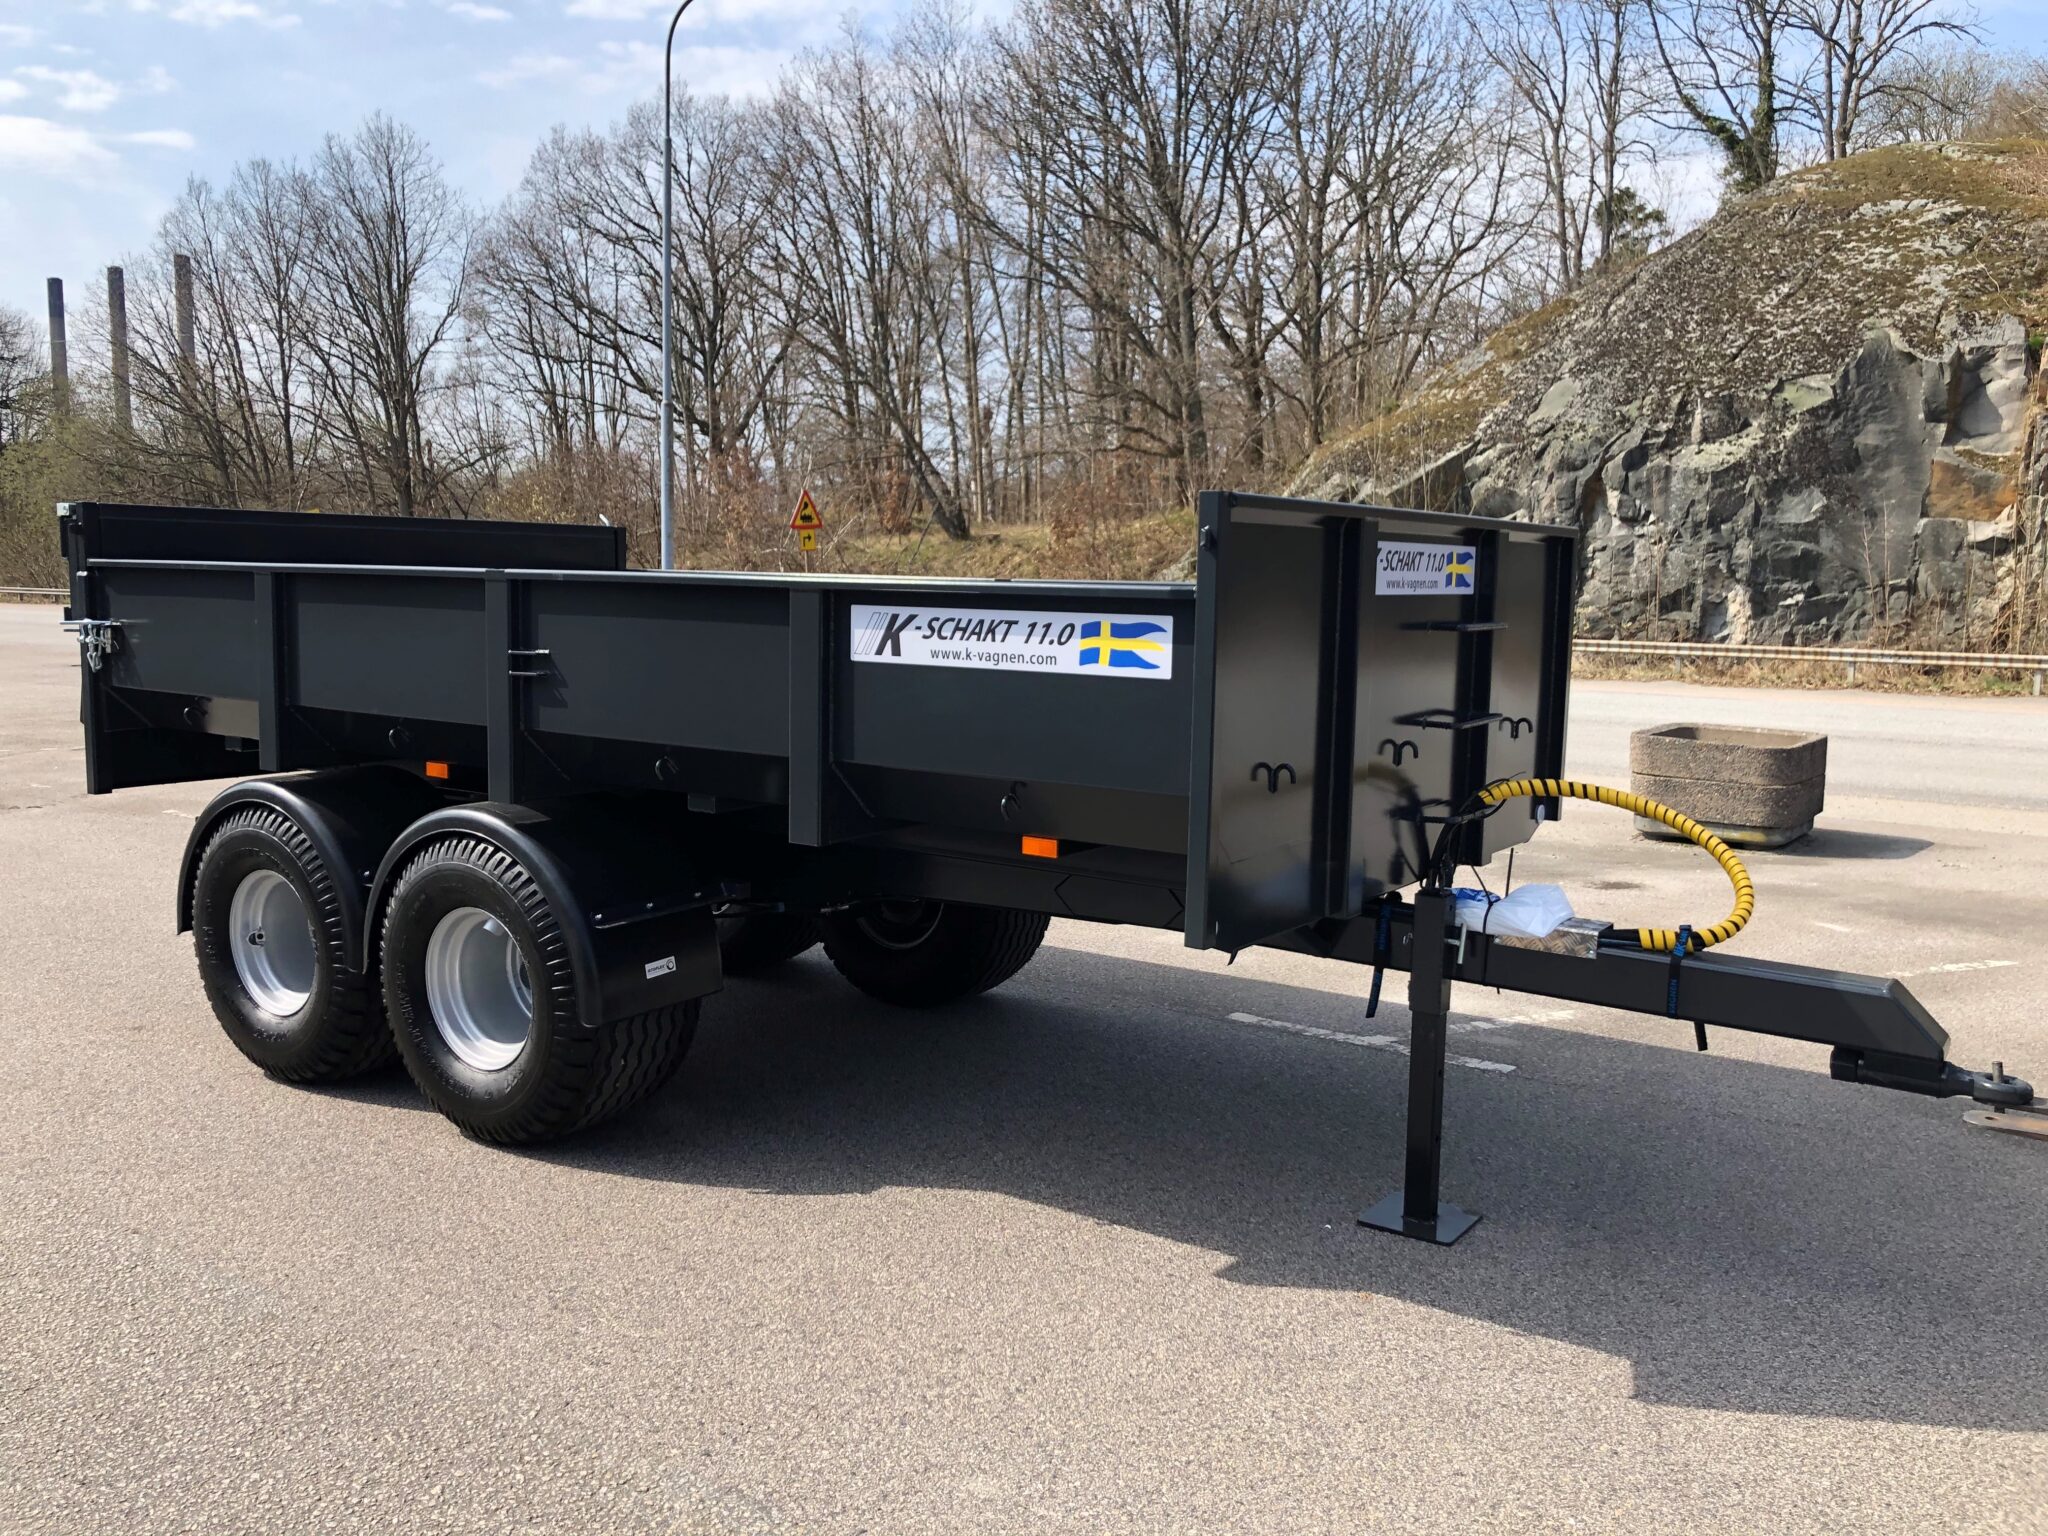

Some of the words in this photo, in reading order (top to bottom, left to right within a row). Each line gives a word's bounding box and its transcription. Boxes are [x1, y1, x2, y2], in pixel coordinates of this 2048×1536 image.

[1377, 548, 1424, 572] -SCHAKT
[1426, 553, 1445, 572] 11.0
[1386, 577, 1438, 592] www.k-vagnen.com
[1024, 621, 1075, 646] 11.0
[930, 647, 1057, 667] www.k-vagnen.com
